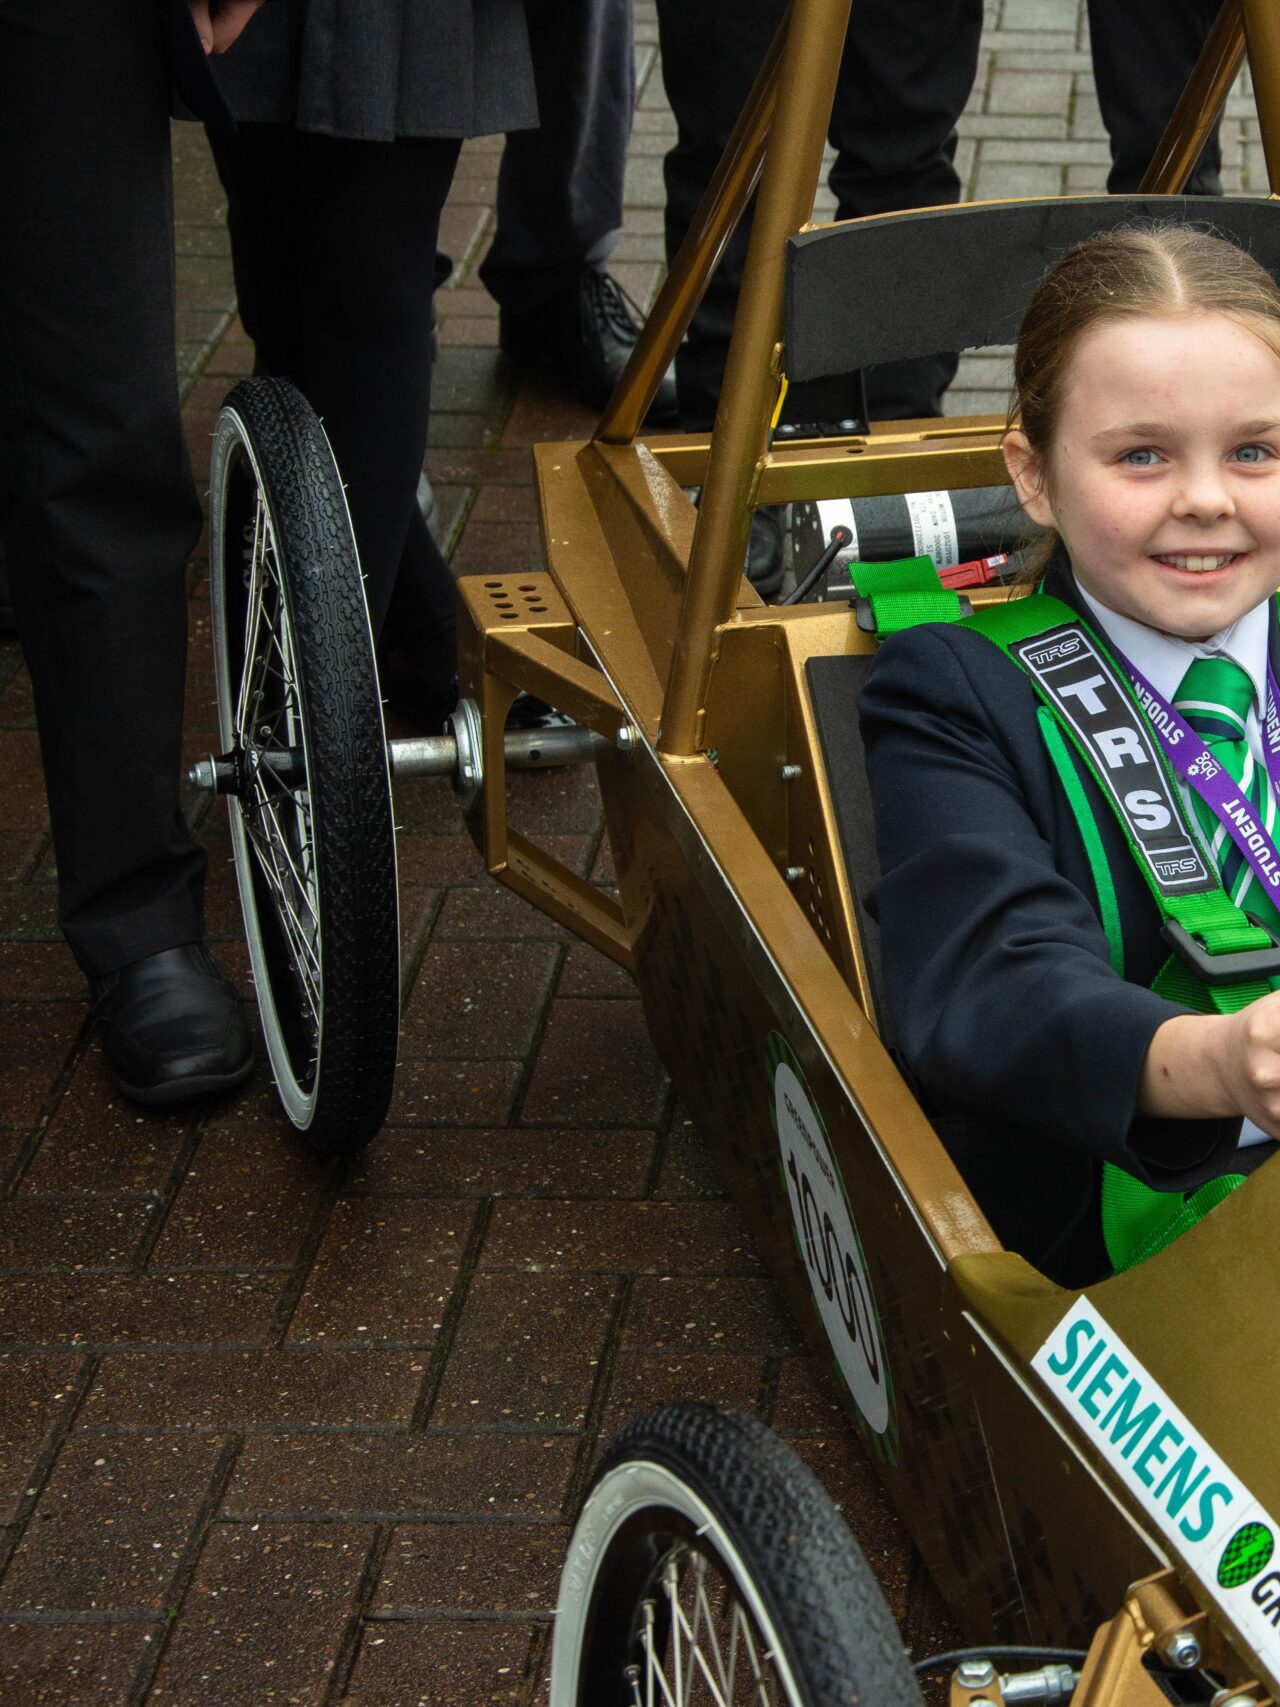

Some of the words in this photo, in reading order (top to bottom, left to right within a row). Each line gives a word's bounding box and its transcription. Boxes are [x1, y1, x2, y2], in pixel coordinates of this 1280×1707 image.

[1029, 638, 1081, 665] TRS
[1131, 676, 1184, 745] STUDEN
[1056, 674, 1171, 831] TRS
[1195, 751, 1218, 781] bbg
[1155, 857, 1197, 876] TRS
[787, 1148, 879, 1385] 1000
[1047, 1319, 1234, 1543] SIEMENS
